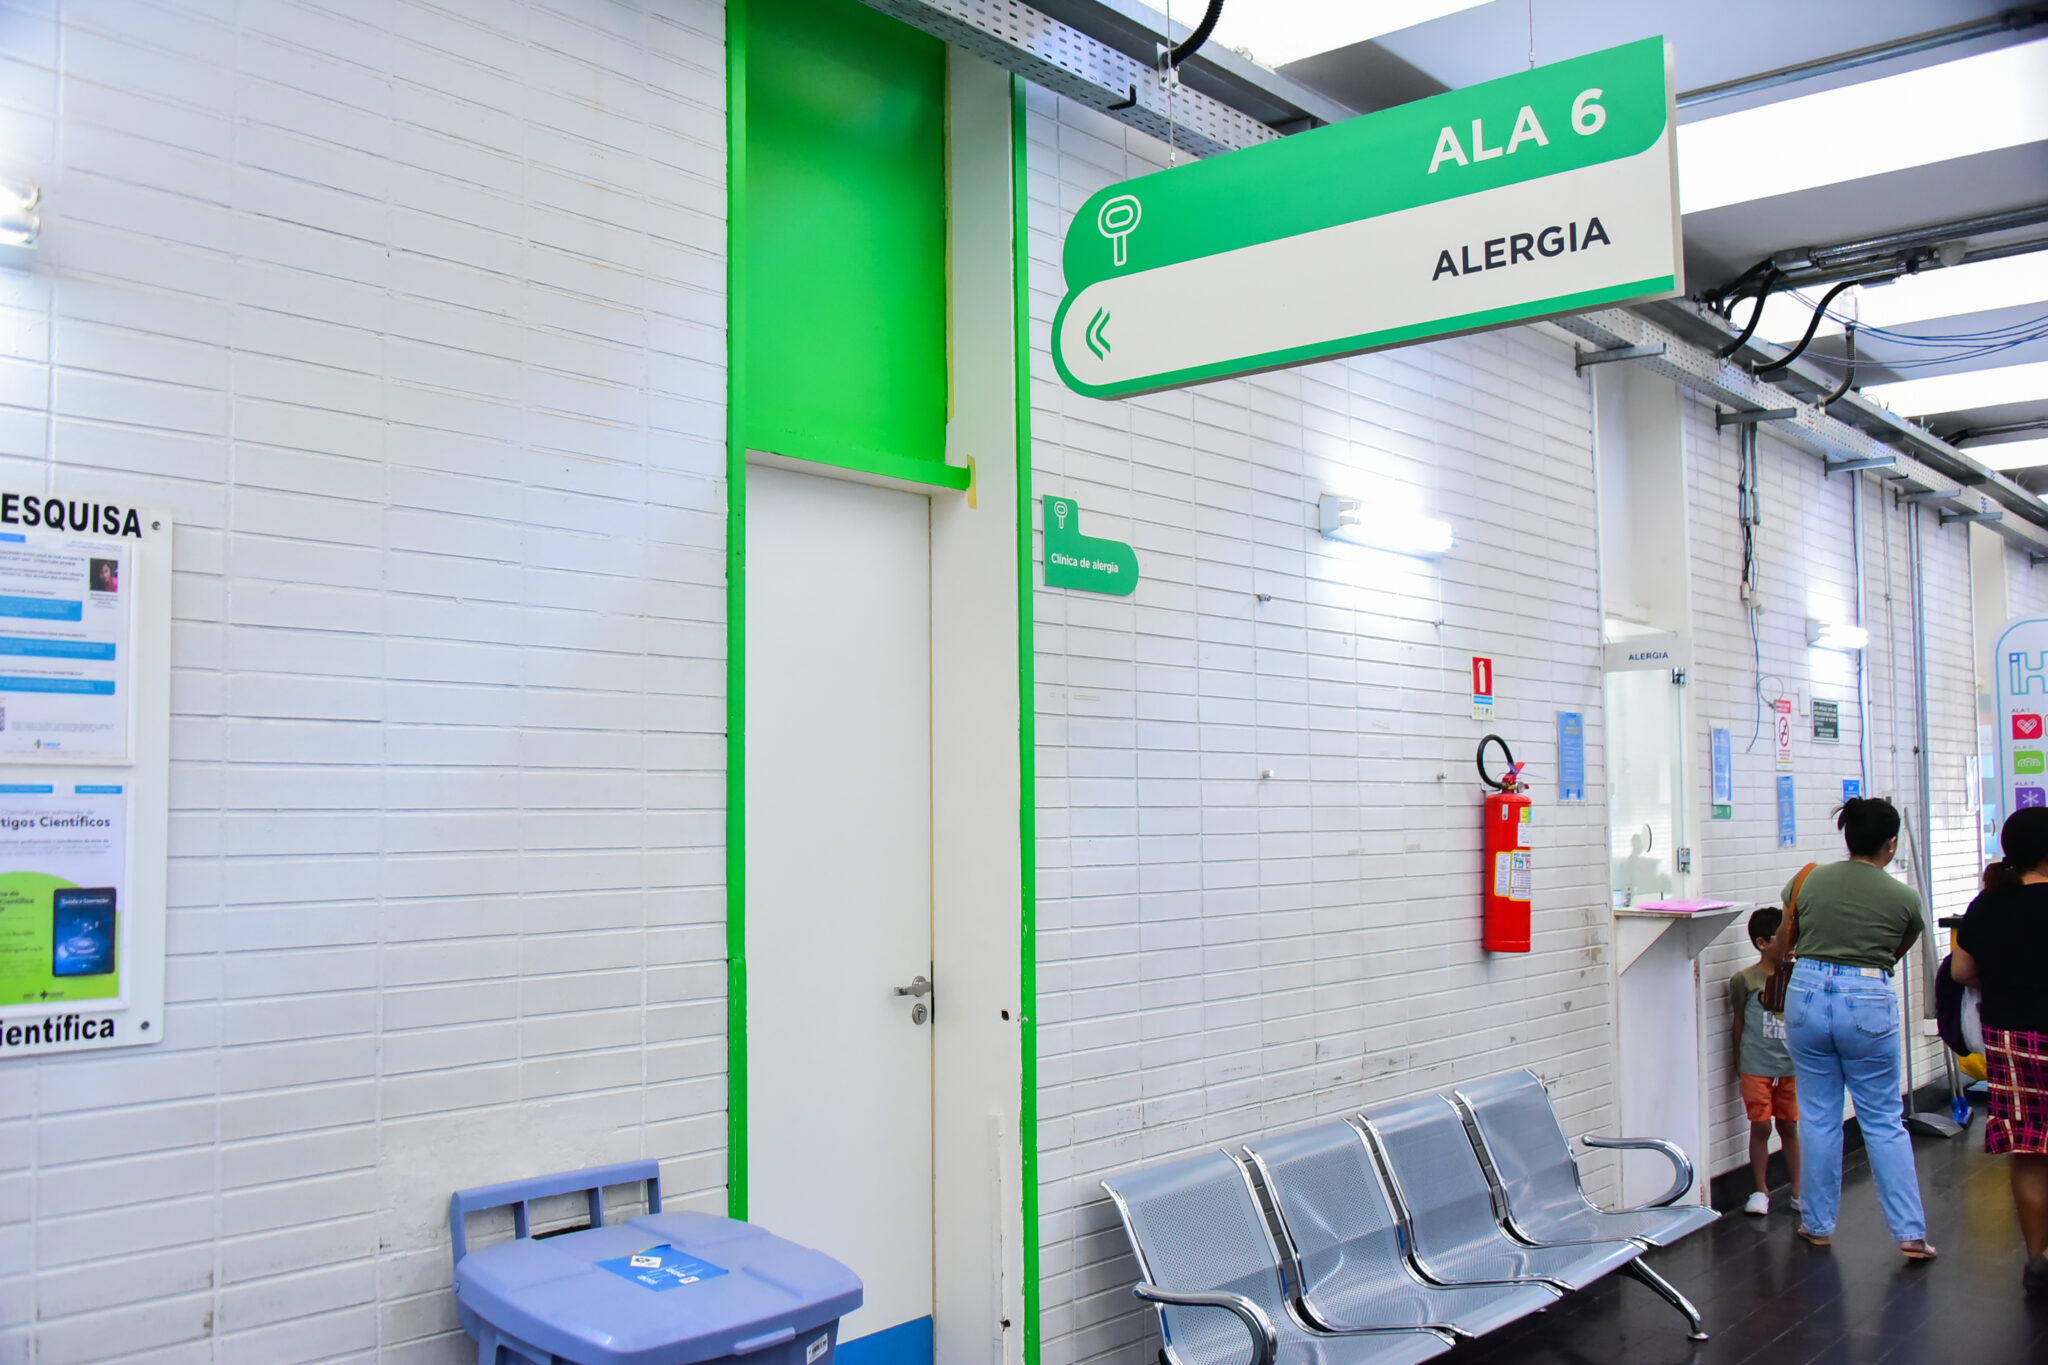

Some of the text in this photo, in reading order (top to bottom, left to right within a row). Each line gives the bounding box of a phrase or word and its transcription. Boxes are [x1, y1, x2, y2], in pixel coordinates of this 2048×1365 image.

[1427, 87, 1607, 174] ALA 6
[1431, 216, 1611, 282] ALERGIA
[1051, 553, 1119, 574] Clínica de alergia
[1628, 651, 1669, 661] ALERGIA
[40, 815, 111, 827] Científicos
